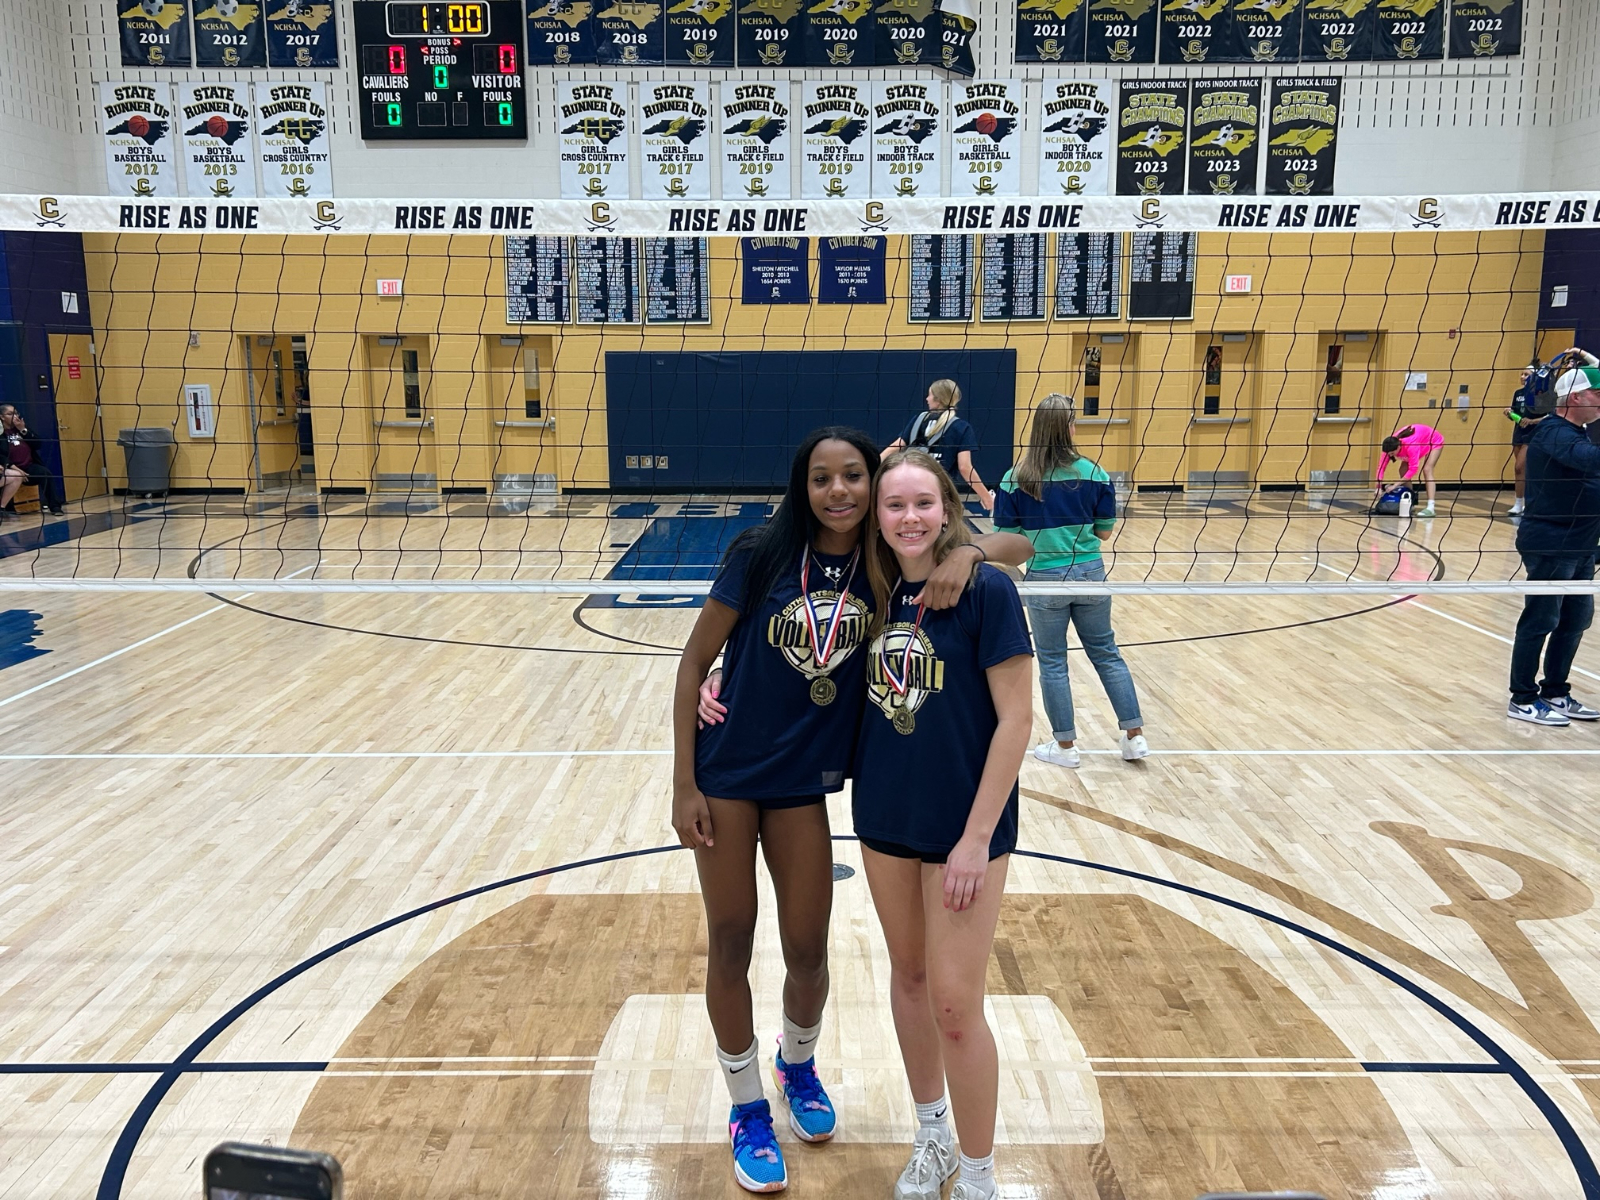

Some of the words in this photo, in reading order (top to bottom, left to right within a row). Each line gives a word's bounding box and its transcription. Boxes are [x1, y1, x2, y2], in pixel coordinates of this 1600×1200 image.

[422, 5, 481, 32] 1:00
[1468, 19, 1502, 32] 2022
[684, 29, 717, 40] 2019
[755, 29, 788, 41] 2019
[824, 29, 858, 40] 2020
[891, 28, 925, 40] 2020
[1034, 25, 1065, 37] 2021
[1105, 25, 1137, 37] 2021
[1178, 25, 1212, 37] 2022
[1248, 26, 1282, 38] 2022
[1321, 23, 1354, 35] 2022
[1392, 22, 1425, 34] 2022
[140, 34, 170, 44] 2011
[213, 35, 248, 45] 2012
[286, 35, 320, 45] 2017
[546, 33, 580, 43] 2018
[613, 33, 647, 44] 2018
[943, 31, 966, 46] 021
[389, 46, 405, 74] 0
[424, 56, 457, 64] PERIOD
[499, 45, 515, 73] 0
[363, 76, 409, 89] CAVALIERS
[434, 66, 448, 88] 0
[472, 75, 521, 88] VISITOR
[115, 86, 156, 100] STATE
[194, 86, 234, 100] STATE
[271, 86, 311, 100] STATE
[372, 92, 400, 101] FOULS
[425, 92, 437, 101] NO
[458, 92, 463, 101] F
[484, 92, 512, 101] FOULS
[572, 85, 613, 100] STATE
[654, 85, 694, 100] STATE
[735, 84, 776, 100] STATE
[816, 84, 857, 100] STATE
[886, 84, 927, 99] STATE
[966, 83, 1007, 98] STATE
[1057, 82, 1098, 98] STATE
[1129, 93, 1177, 107] STATE
[1202, 92, 1249, 107] STATE
[1281, 91, 1329, 105] STATE
[104, 101, 152, 119] RUNNER
[183, 101, 231, 119] RUNNER
[260, 101, 307, 118] RUNNER
[387, 103, 400, 126] 0
[499, 103, 512, 125] 0
[561, 100, 607, 118] RUNNER
[642, 101, 688, 118] RUNNER
[724, 100, 769, 118] RUNNER
[805, 100, 850, 118] RUNNER
[874, 100, 920, 118] RUNNER
[954, 99, 1001, 117] RUNNER
[1044, 99, 1091, 116] RUNNER
[1273, 104, 1336, 125] CHAMPIONS
[1121, 107, 1185, 127] CHAMPIONS
[1194, 105, 1257, 126] CHAMPIONS
[125, 164, 159, 175] 2012
[204, 164, 237, 175] 2013
[281, 164, 314, 174] 2016
[578, 163, 611, 174] 2017
[660, 163, 693, 174] 2017
[740, 163, 773, 174] 2019
[819, 163, 853, 174] 2019
[889, 162, 923, 174] 2019
[969, 162, 1003, 173] 2019
[1057, 161, 1091, 172] 2020
[1134, 162, 1168, 173] 2023
[1207, 160, 1240, 172] 2023
[1284, 160, 1317, 171] 2023
[39, 198, 59, 218] C
[316, 201, 335, 222] C
[591, 203, 610, 222] C
[866, 202, 884, 222] C
[1142, 199, 1160, 219] C
[1419, 198, 1437, 218] C
[1496, 201, 1550, 224] RISE
[1554, 201, 1585, 223] AS
[119, 205, 171, 228] RISE
[178, 206, 207, 229] AS
[216, 206, 259, 229] ONE
[395, 207, 446, 229] RISE
[453, 206, 482, 229] AS
[490, 207, 534, 229] ONE
[668, 209, 720, 231] RISE
[726, 209, 757, 232] AS
[764, 209, 808, 232] ONE
[942, 206, 994, 229] RISE
[1001, 206, 1029, 228] AS
[1038, 205, 1083, 228] ONE
[1218, 204, 1271, 227] RISE
[1276, 205, 1308, 227] AS
[1314, 204, 1361, 227] ONE
[382, 282, 398, 294] EXIT
[1231, 277, 1248, 290] EXIT
